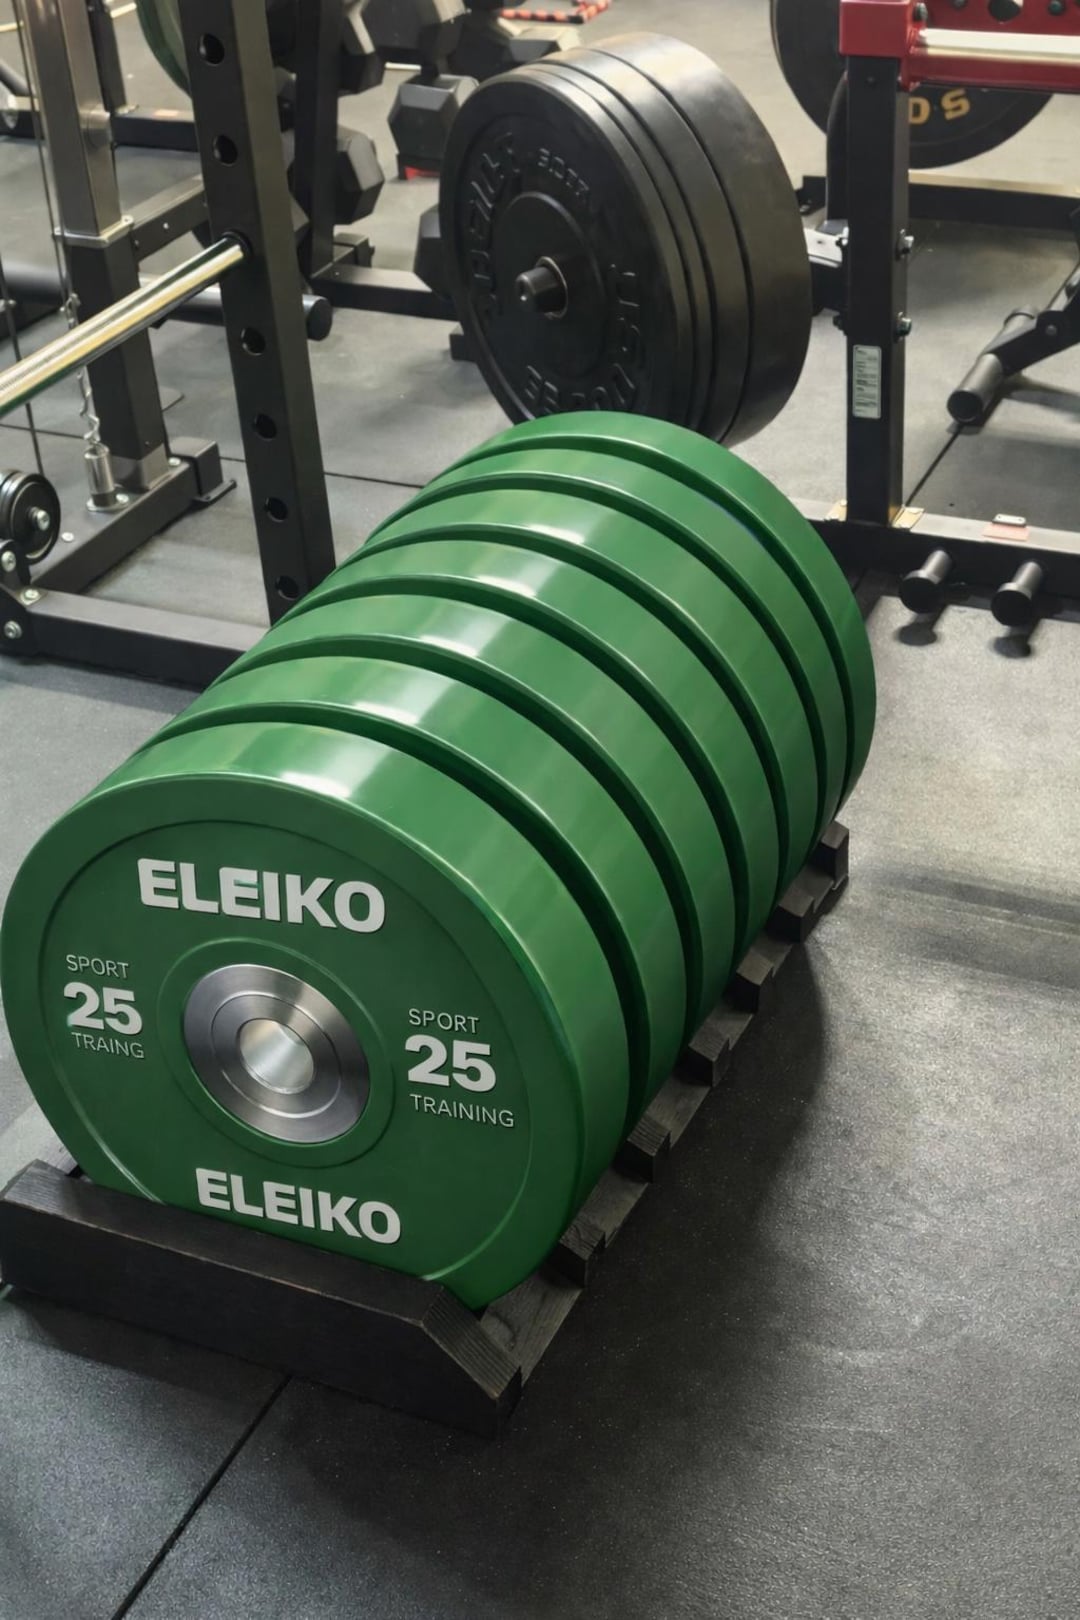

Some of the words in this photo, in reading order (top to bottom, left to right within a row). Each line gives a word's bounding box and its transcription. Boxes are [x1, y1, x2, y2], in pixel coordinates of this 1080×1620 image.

[137, 858, 386, 933] ELEIKO
[66, 954, 129, 979] SPORT
[63, 982, 143, 1035] 25
[409, 1008, 479, 1034] SPORT
[71, 1031, 145, 1059] TRAING
[405, 1034, 496, 1092] 25
[409, 1093, 515, 1128] TRAINING
[195, 1167, 401, 1244] ELEIKO
